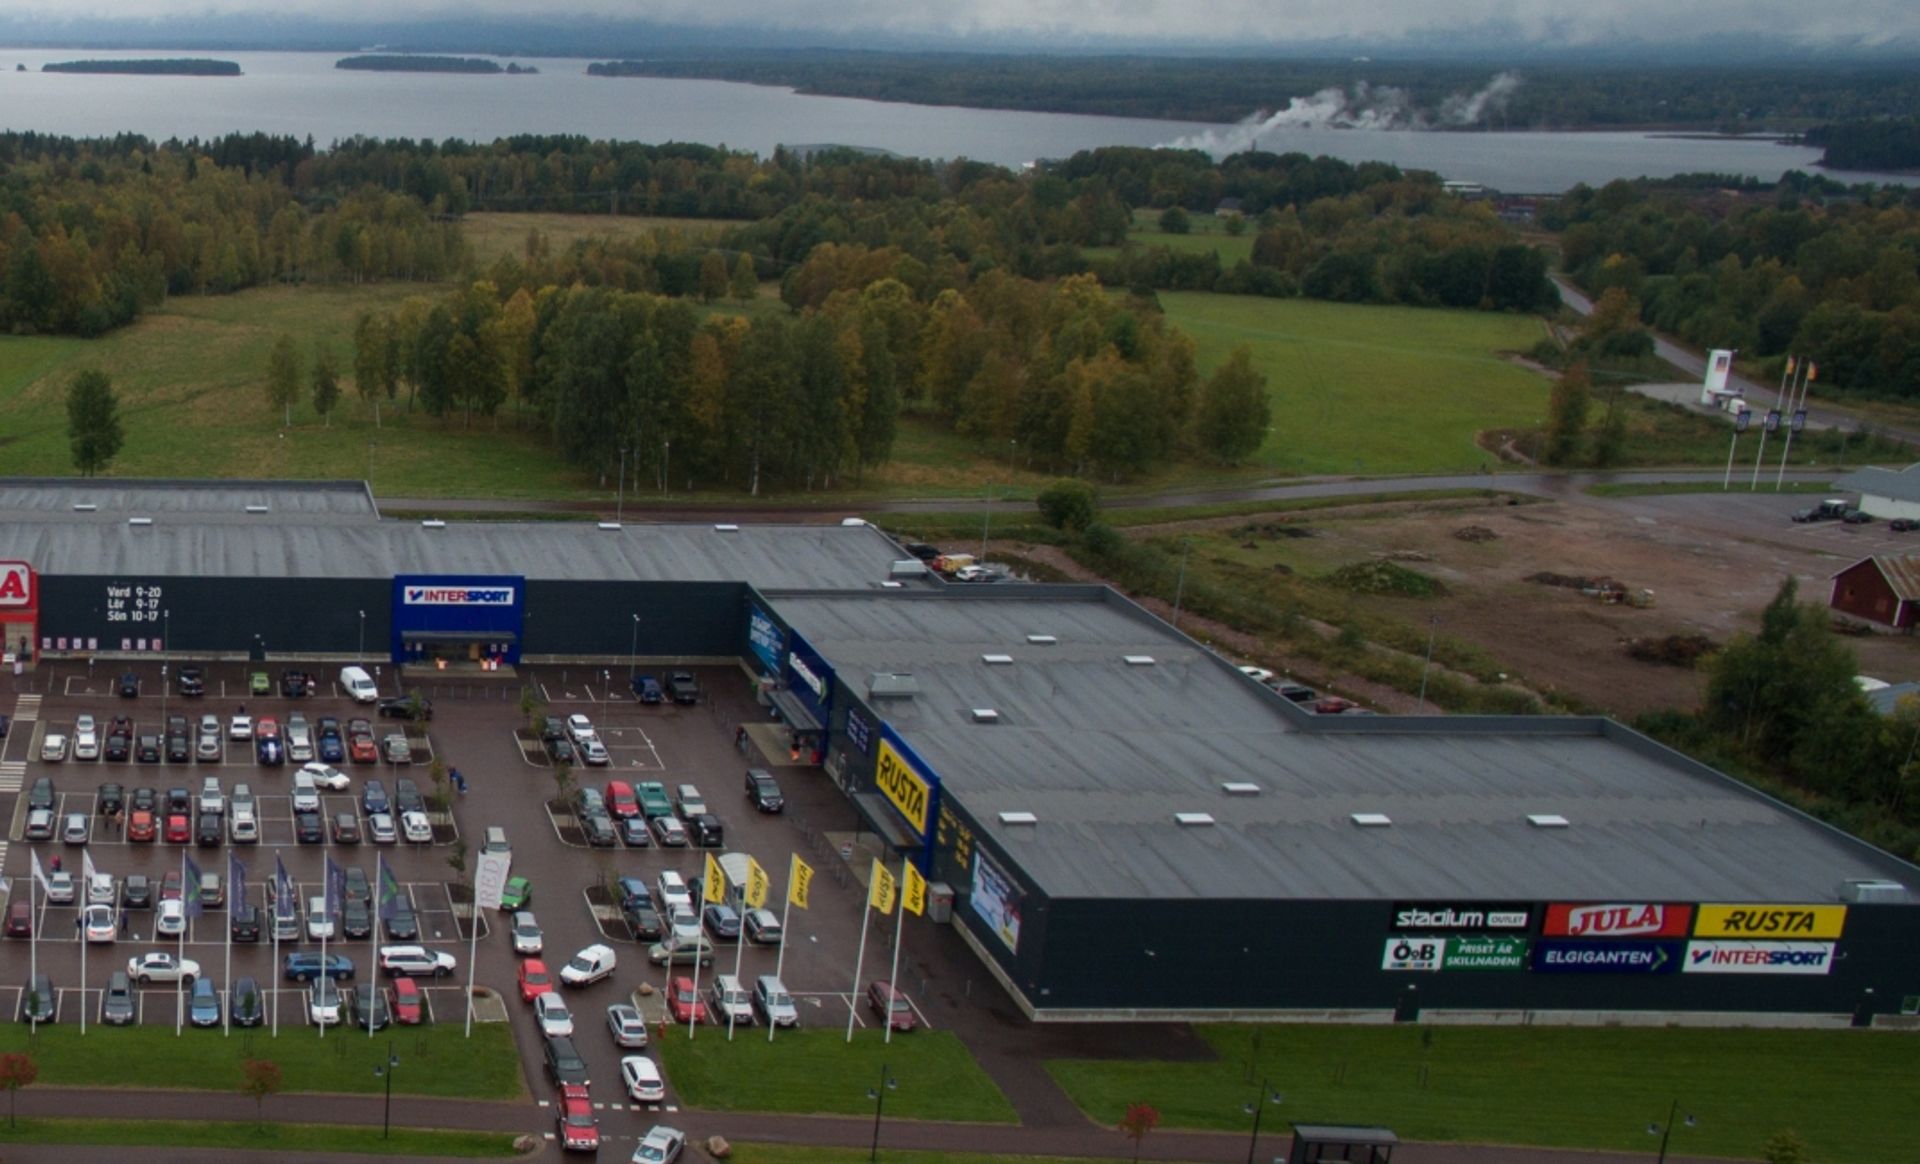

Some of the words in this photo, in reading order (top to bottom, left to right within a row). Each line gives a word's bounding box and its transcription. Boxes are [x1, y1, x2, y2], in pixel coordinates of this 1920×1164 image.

[424, 590, 510, 602] INTERSPORT
[136, 598, 159, 609] 9-17
[132, 610, 159, 621] 10-17
[880, 753, 924, 823] RUSTA
[1396, 908, 1484, 927] stadium
[1570, 904, 1660, 935] JULA
[1723, 910, 1815, 932] RUSTA
[1458, 944, 1494, 954] PRISET
[1446, 956, 1521, 966] SKILLNADEN!
[1545, 951, 1652, 963] ELGIGANTEN
[1712, 950, 1828, 965] INTERSPORT
